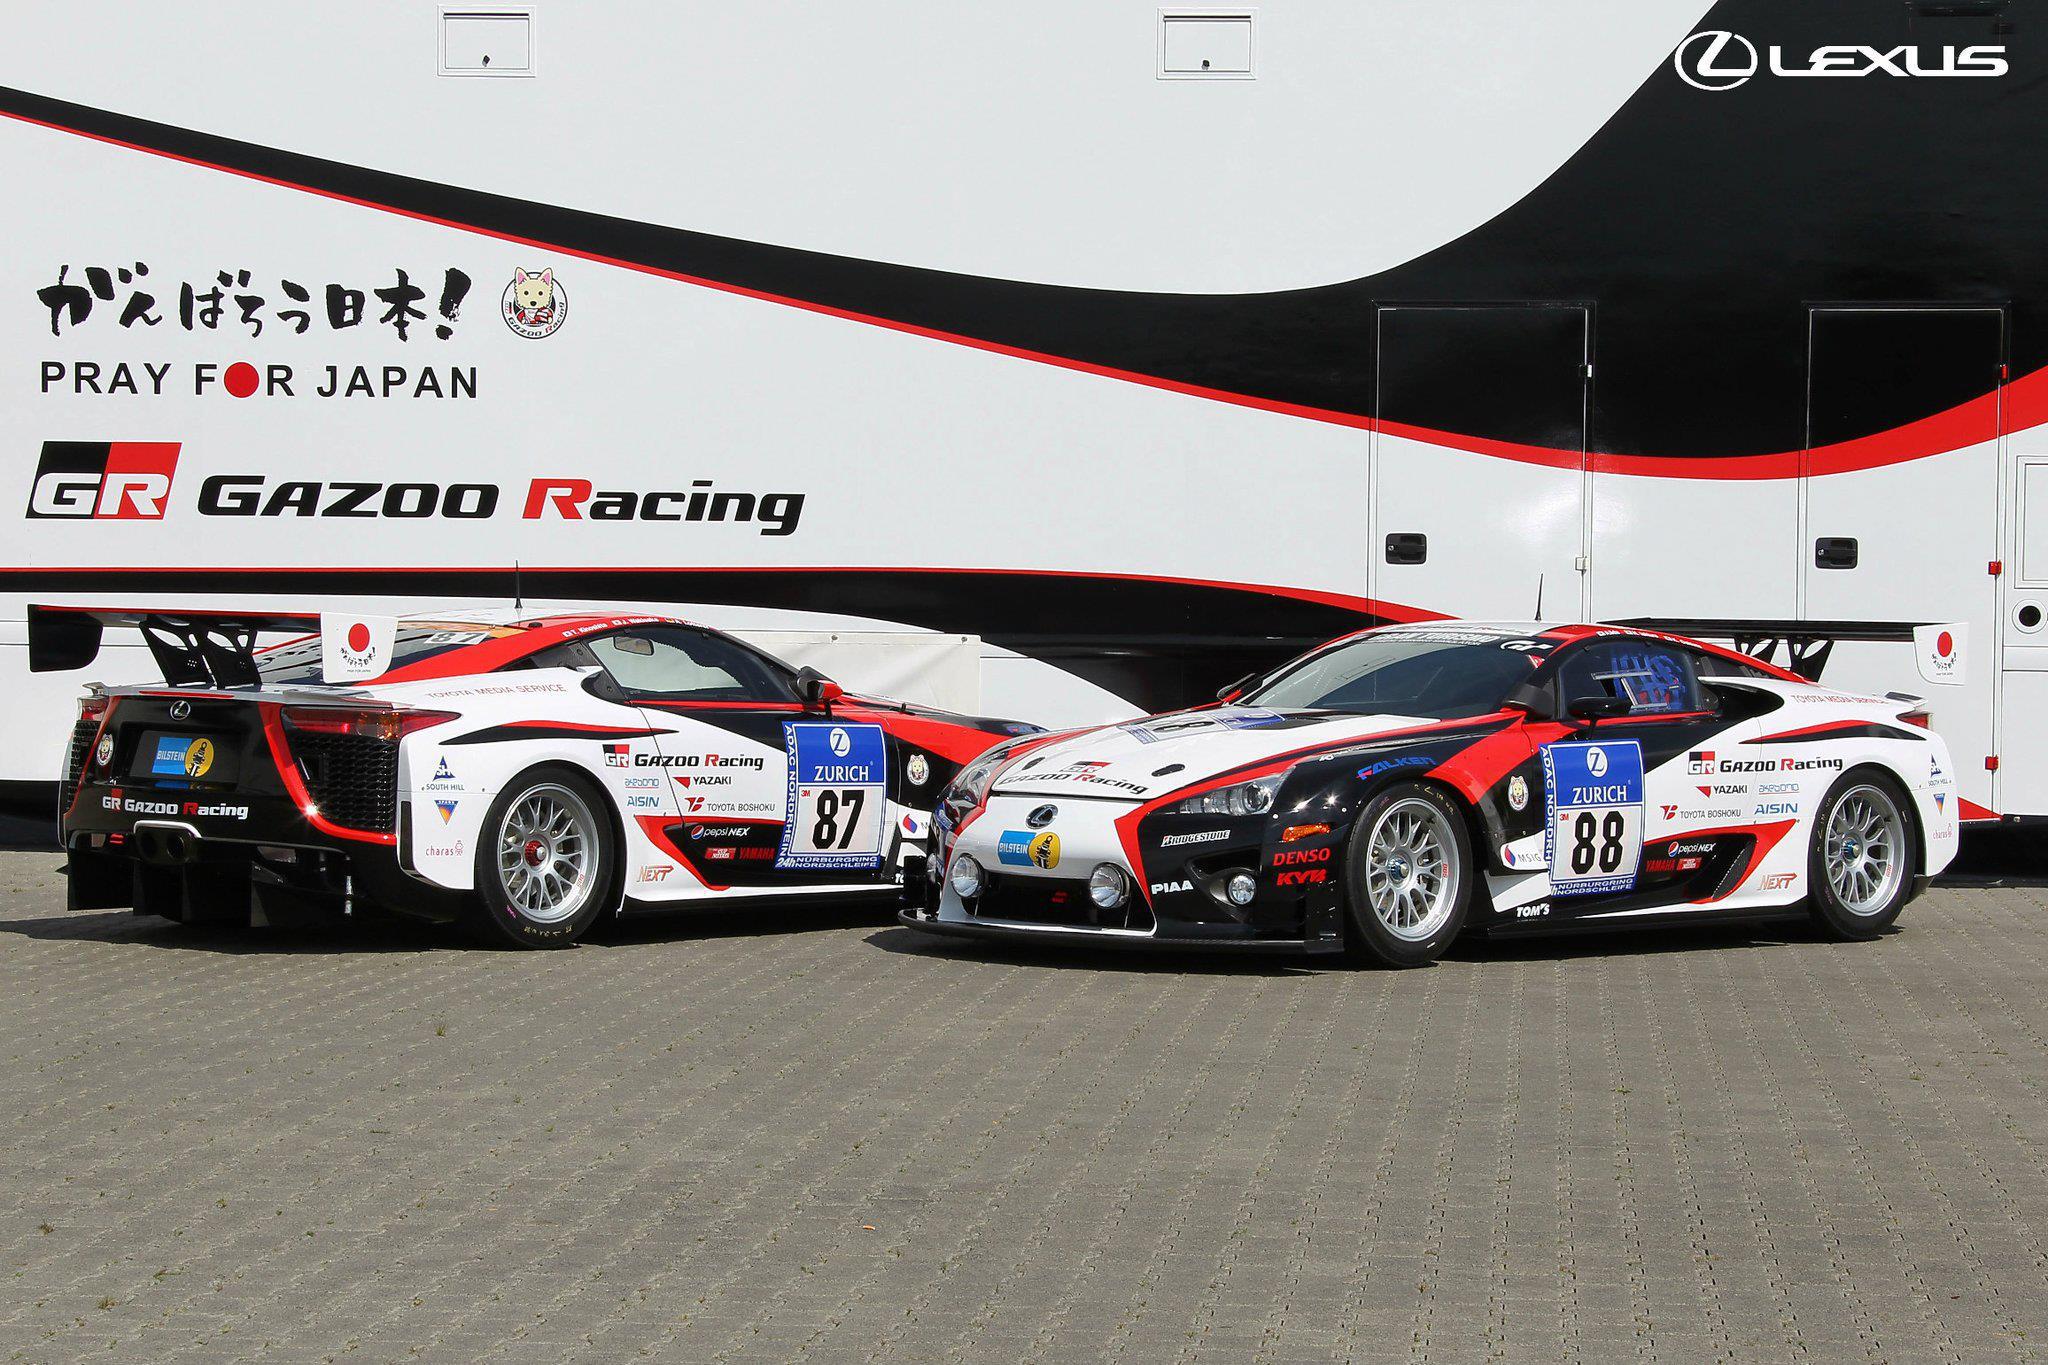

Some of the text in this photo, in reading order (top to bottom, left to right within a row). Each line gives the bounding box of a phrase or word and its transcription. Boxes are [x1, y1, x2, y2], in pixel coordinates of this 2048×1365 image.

[40, 360, 172, 395] PRAY
[316, 365, 478, 399] JAPAN
[31, 471, 806, 537] GR GAZOO Racing
[425, 684, 567, 699] TOYOTA MEDIA SERVICE
[784, 725, 796, 766] ADAC
[156, 750, 186, 762] BILSTEIN
[605, 752, 765, 771] GR GAZOO Racing
[1356, 756, 1438, 781] FALKEN
[1540, 746, 1554, 790] ADAC
[1688, 756, 1844, 775] GR GAZOO Racing
[692, 776, 732, 786] YAZAKI
[814, 765, 869, 782] ZURICH
[426, 783, 449, 791] SOUTH
[997, 773, 1150, 795] GAZOO Racing
[1713, 784, 1748, 794] YAZAKI
[801, 790, 811, 798] 3M
[1572, 785, 1628, 804] ZURICH
[124, 798, 179, 815] GAZOO
[183, 801, 249, 820] Racing
[627, 796, 660, 808] AISIN
[707, 803, 776, 813] TOYOTA BOSHOKU
[1754, 802, 1798, 816] AISIN
[779, 771, 797, 857] NORDRHEIN
[812, 789, 865, 850] 87
[1559, 813, 1569, 822] 3M
[1680, 808, 1742, 819] TOYOTA BOSHOKU
[703, 826, 751, 837] pepsi NEX
[1160, 829, 1231, 848] BRIDGESTONE
[999, 842, 1028, 855] BILSTEIN
[1571, 810, 1625, 875] 88
[1677, 844, 1699, 855] pepsi
[425, 845, 454, 856] charas
[739, 847, 776, 860] YAMAHA
[1272, 848, 1332, 867] DENSO
[1517, 851, 1542, 863] MSIG
[775, 857, 796, 868] 24h
[1645, 858, 1676, 873] YAMAHA
[637, 863, 674, 883] NEXT
[1276, 868, 1328, 886] KYB
[1151, 879, 1194, 895] PIAA
[1558, 878, 1634, 890] NÜRBURGRING
[1757, 872, 1798, 891] NEXT
[1556, 883, 1633, 896] NORDSCHLEIFE
